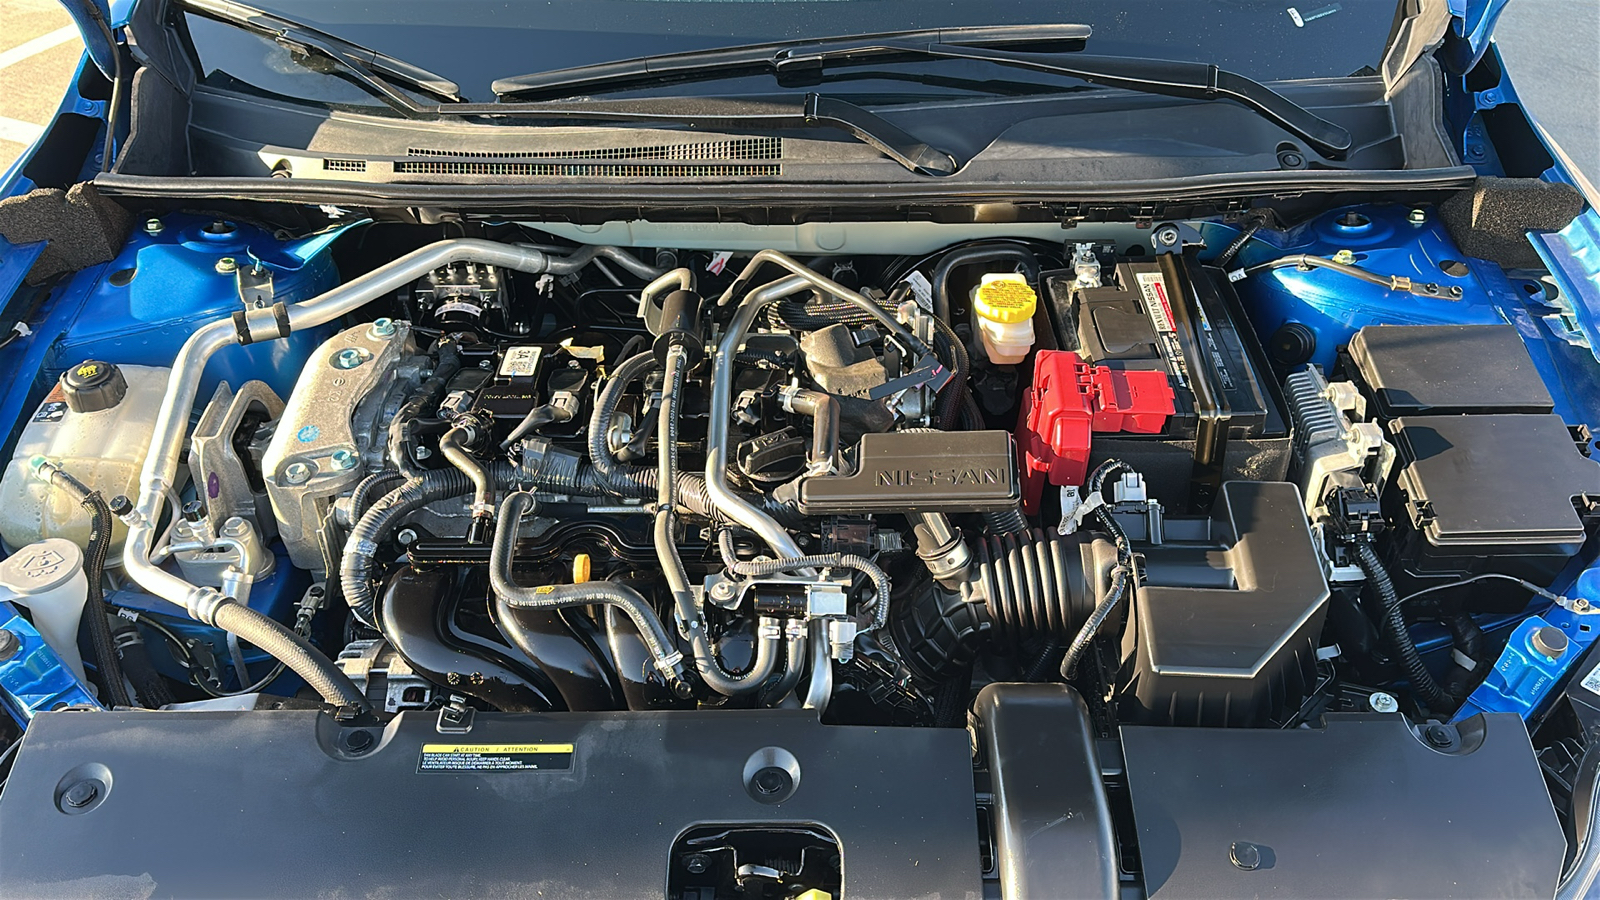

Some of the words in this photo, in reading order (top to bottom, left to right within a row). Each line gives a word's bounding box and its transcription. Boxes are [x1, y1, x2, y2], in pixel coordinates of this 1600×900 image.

[1143, 283, 1157, 309] NISSAN
[516, 349, 530, 360] 3A
[874, 468, 1006, 487] NISSAN
